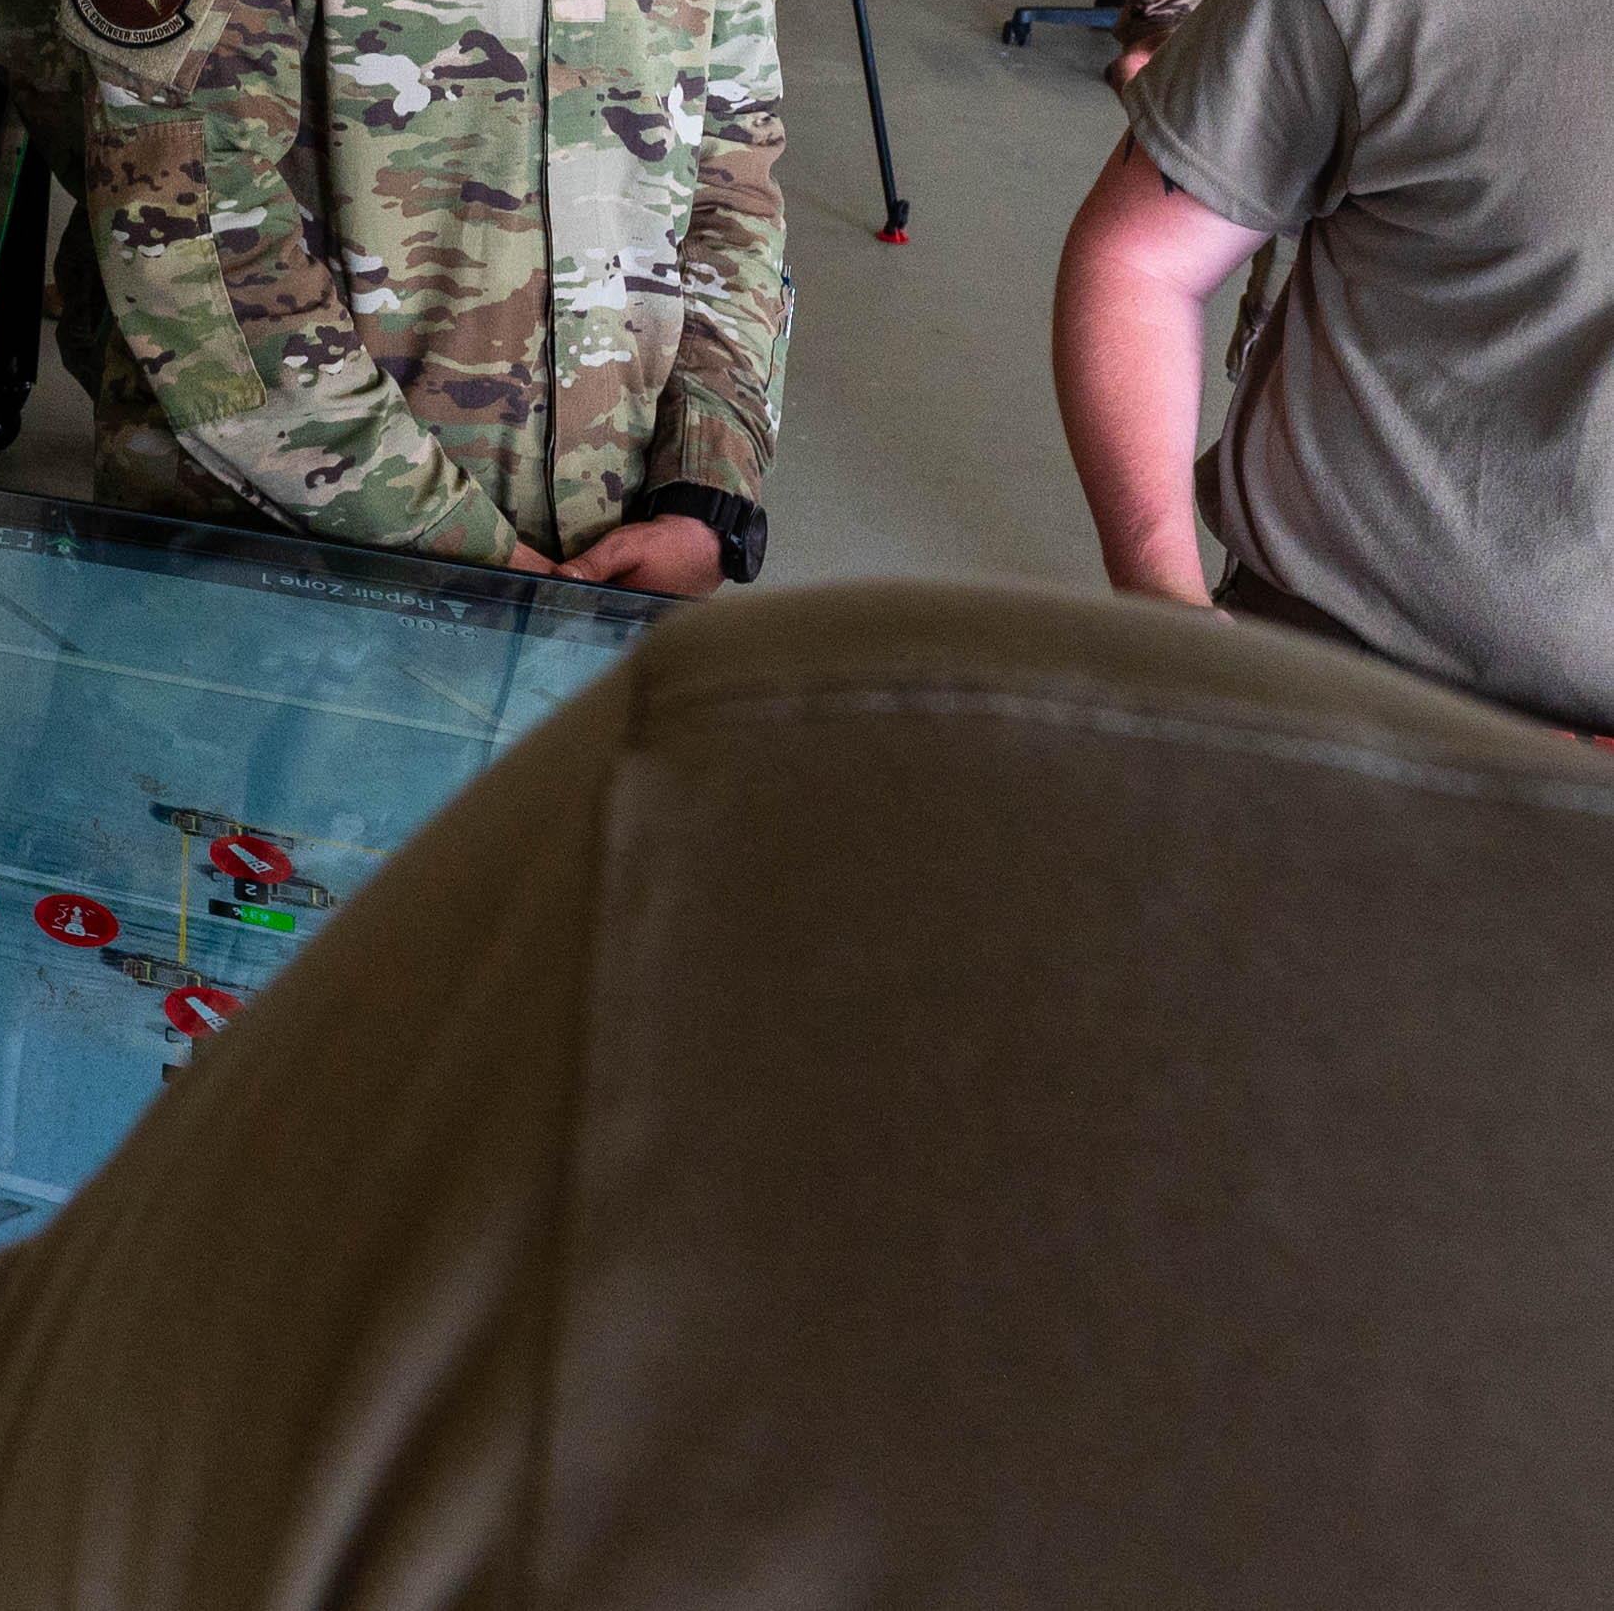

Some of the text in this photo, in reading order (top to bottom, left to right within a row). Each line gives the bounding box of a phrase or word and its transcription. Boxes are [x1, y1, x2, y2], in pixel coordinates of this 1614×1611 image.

[90, 13, 132, 41] ENGINEER
[133, 16, 184, 42] SQUADRON
[261, 572, 435, 612] Repair Zone 1
[244, 883, 258, 897] 2
